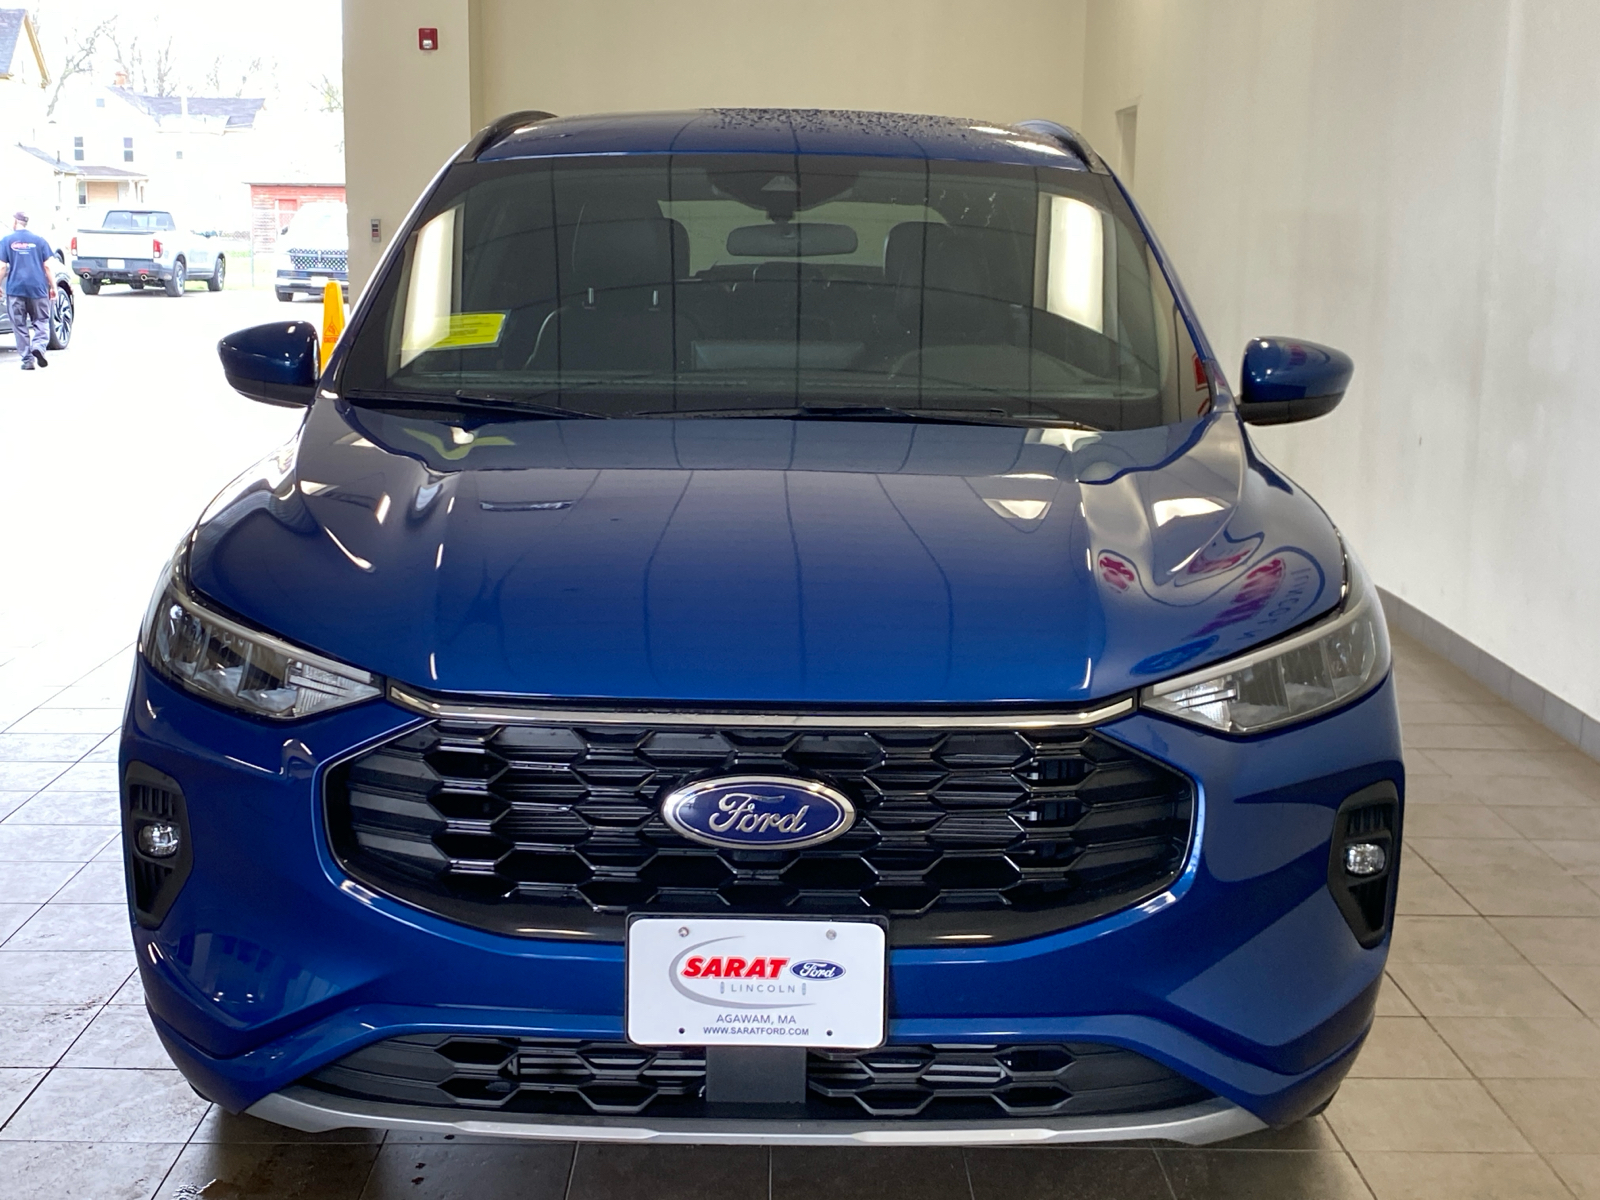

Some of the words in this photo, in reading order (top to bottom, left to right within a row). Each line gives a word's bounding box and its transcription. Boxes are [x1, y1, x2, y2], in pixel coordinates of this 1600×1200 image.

[708, 792, 810, 833] Ford
[681, 956, 789, 979] SARAT
[797, 961, 838, 979] Ford
[730, 984, 795, 994] LINCOLN
[716, 1014, 774, 1025] AGAWAM,
[777, 1015, 797, 1024] MA
[703, 1026, 809, 1036] WWW.SARATFORD.COM
